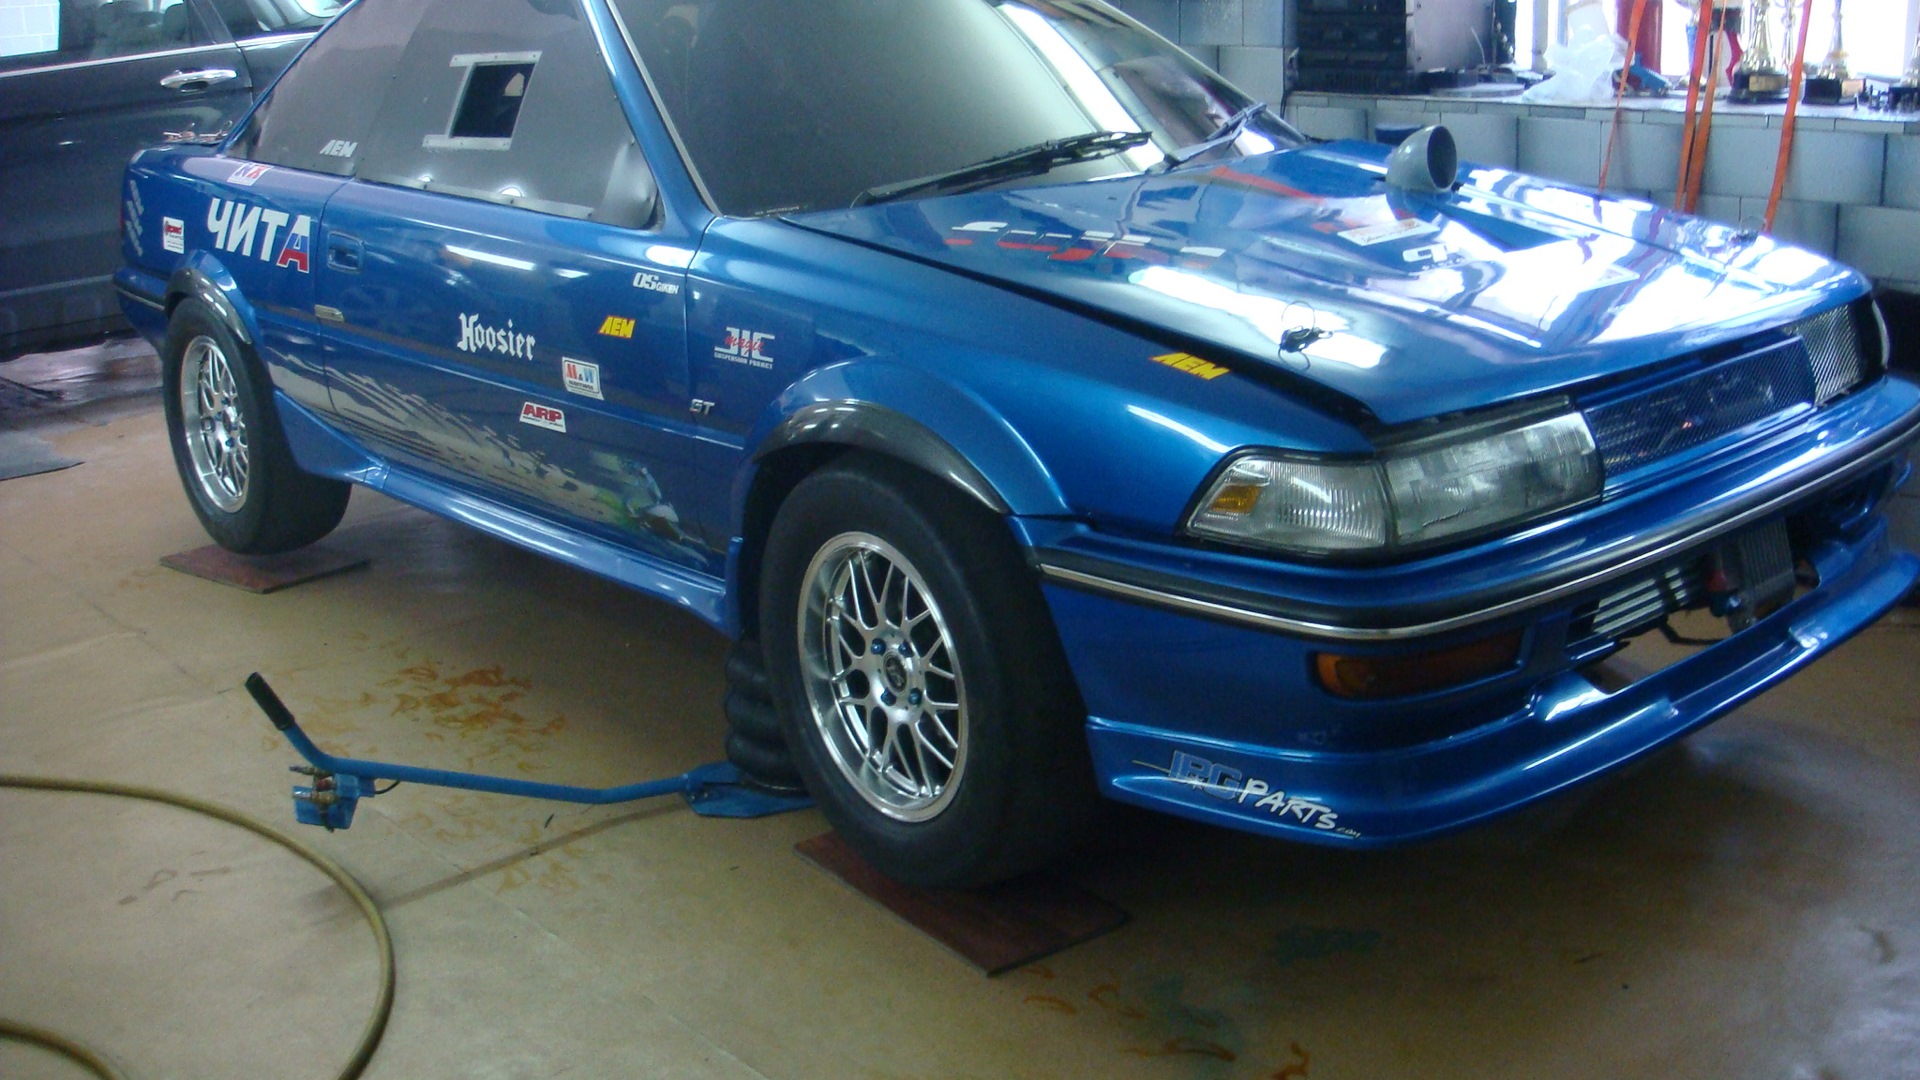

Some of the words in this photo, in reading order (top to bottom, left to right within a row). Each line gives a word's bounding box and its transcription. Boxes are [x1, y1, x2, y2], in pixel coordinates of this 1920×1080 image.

[319, 139, 358, 158] AEM
[206, 197, 311, 274] ЧИТА
[632, 271, 660, 291] OS
[456, 311, 536, 361] Hoosier
[598, 315, 636, 339] AEM
[1149, 351, 1231, 381] AEM
[522, 403, 563, 422] ARP
